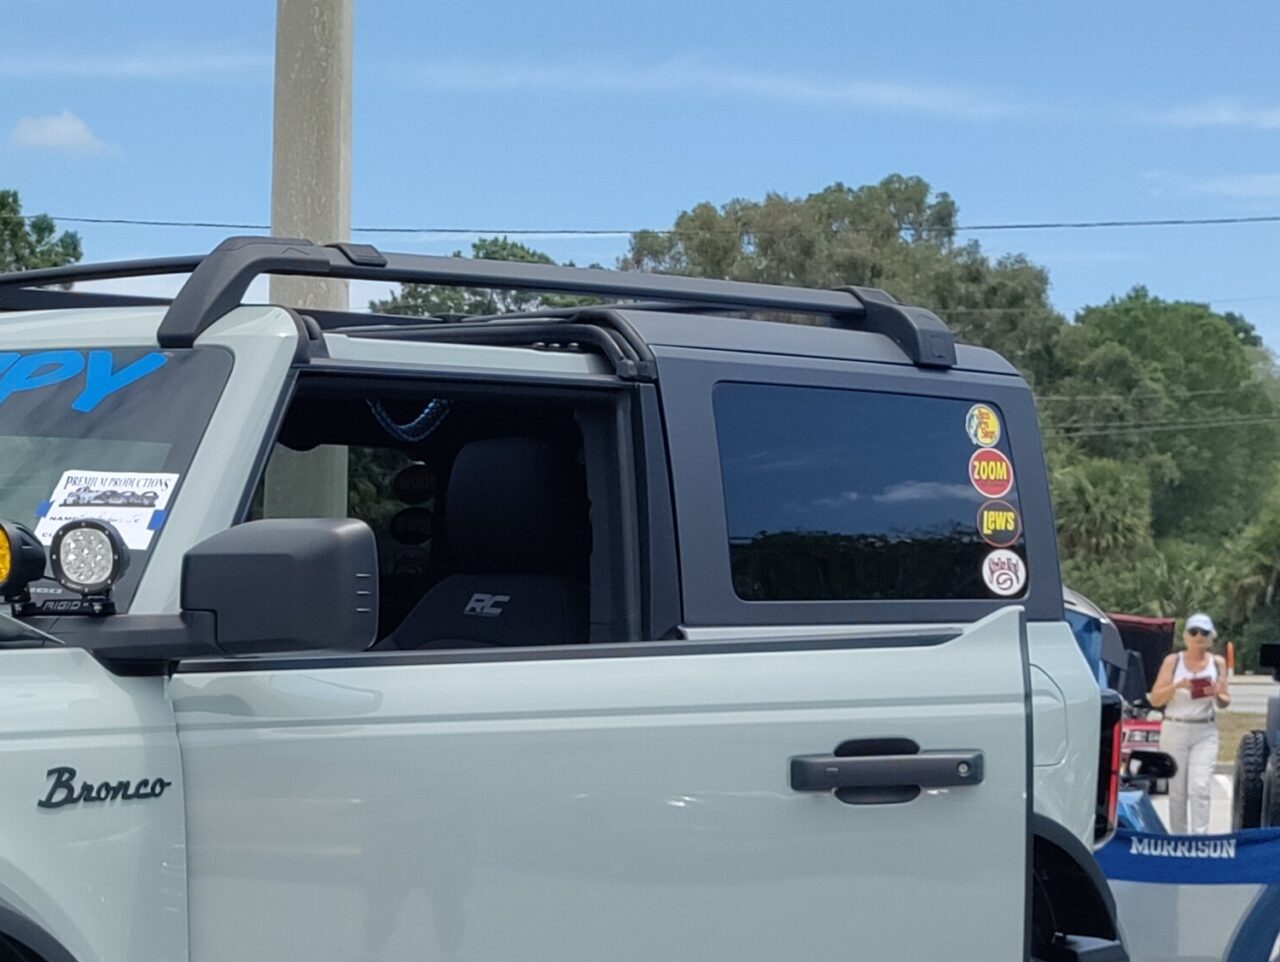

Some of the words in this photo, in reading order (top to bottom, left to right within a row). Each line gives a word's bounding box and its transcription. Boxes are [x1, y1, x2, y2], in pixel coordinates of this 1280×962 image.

[973, 460, 1008, 480] ZOOM
[43, 601, 81, 611] RIGID
[464, 593, 511, 617] RC
[37, 766, 172, 808] Bronco
[1129, 836, 1236, 858] MORRISON
